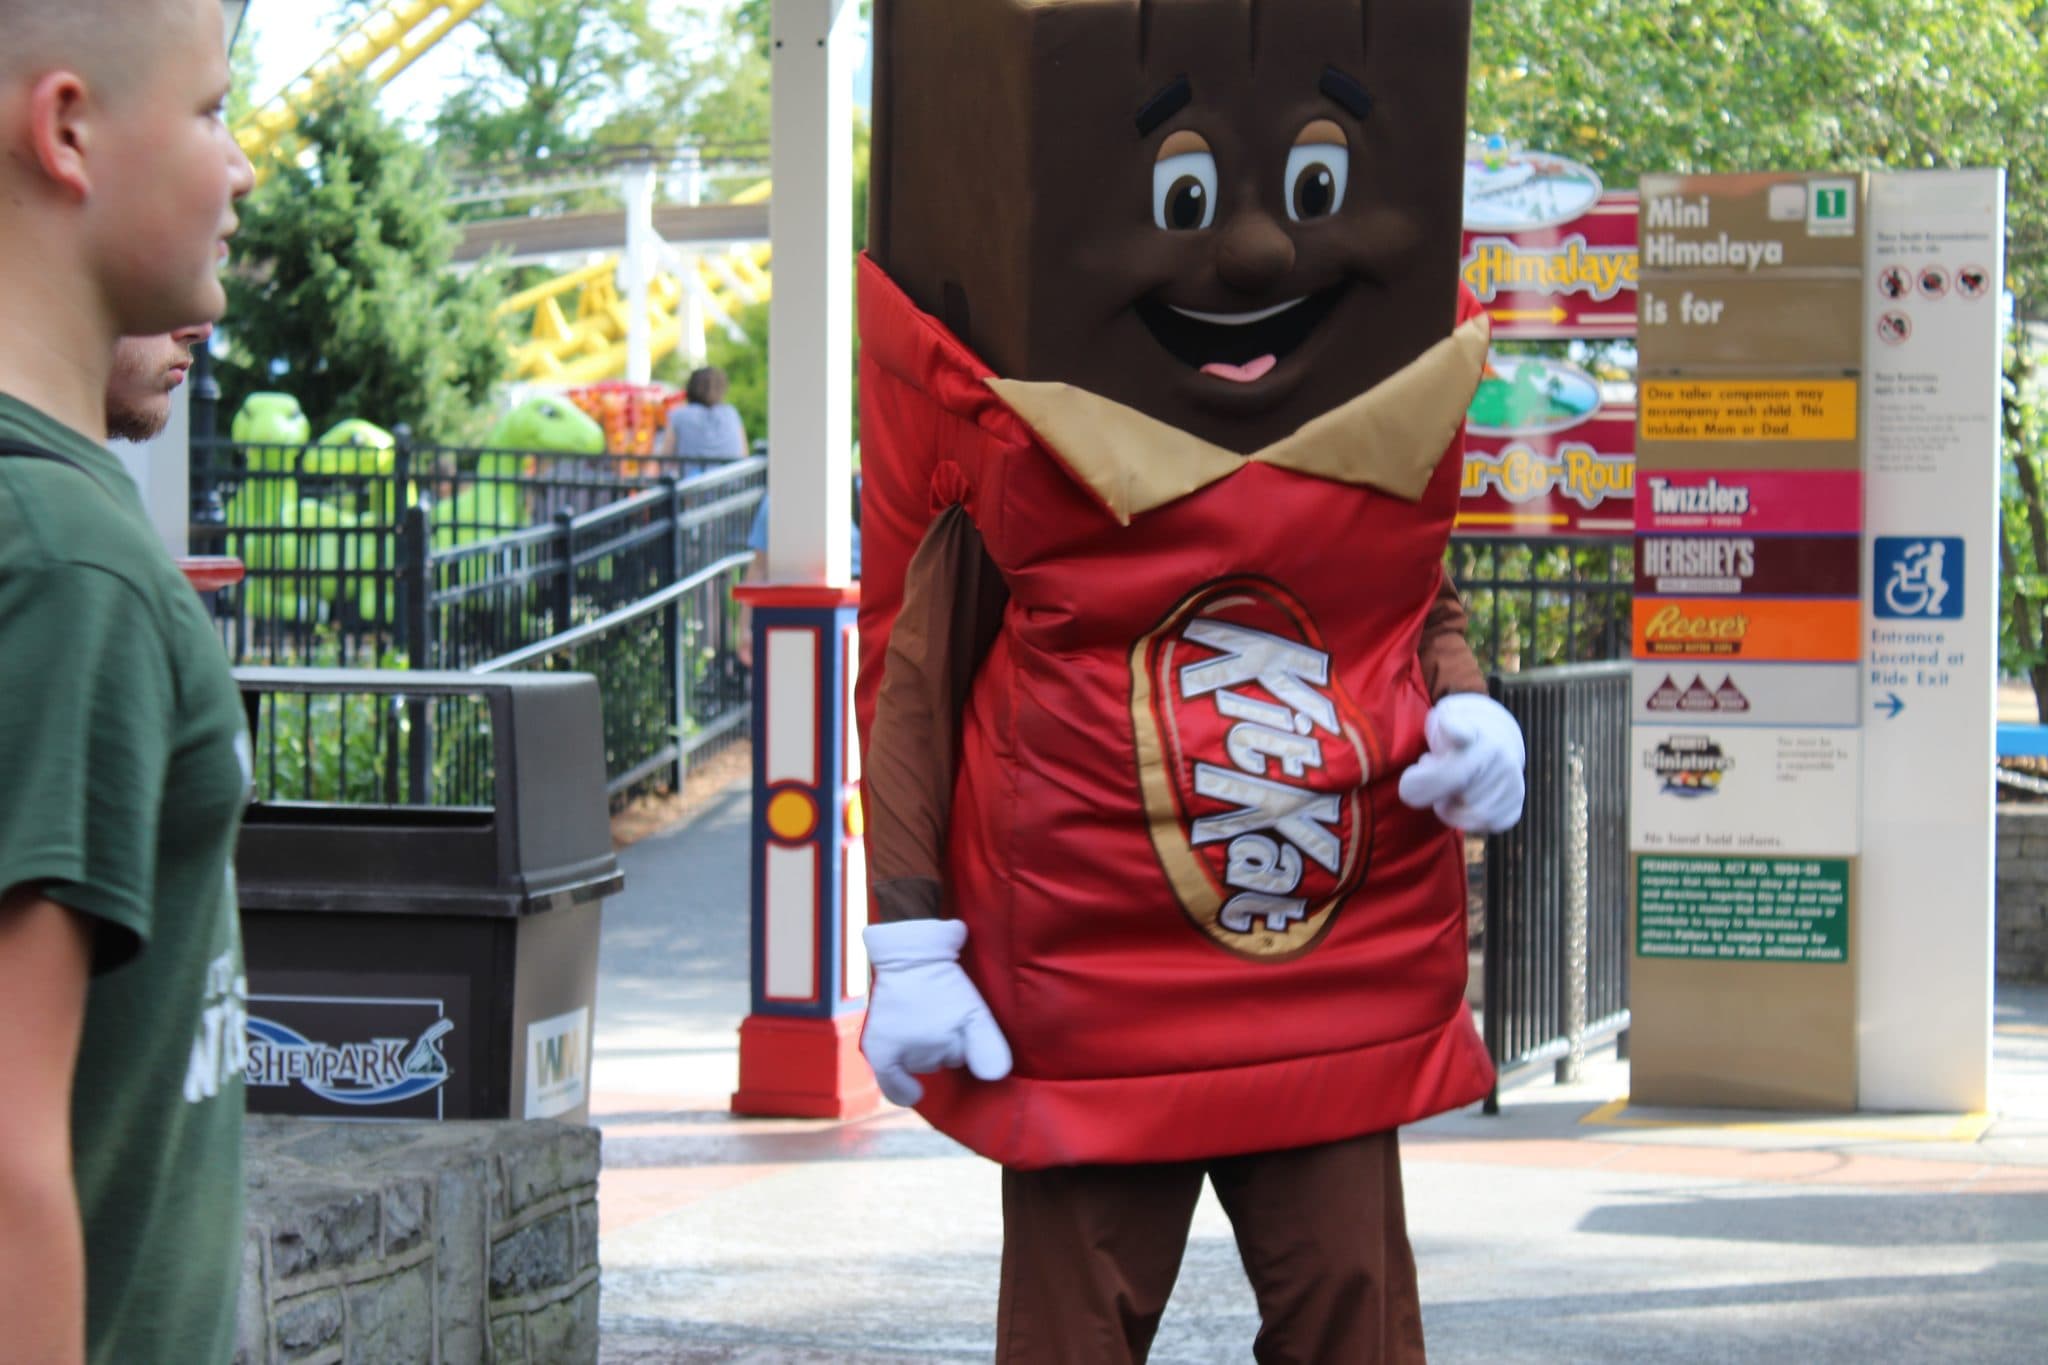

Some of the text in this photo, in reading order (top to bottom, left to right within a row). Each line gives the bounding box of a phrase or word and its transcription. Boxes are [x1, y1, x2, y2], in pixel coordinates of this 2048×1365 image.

[1646, 194, 1709, 227] Mini
[1825, 190, 1836, 217] 1
[1646, 232, 1783, 273] Himalaya
[1644, 291, 1724, 324] is for
[1648, 387, 1824, 403] One taller companion may
[1647, 406, 1719, 419] accompany
[1727, 404, 1757, 417] each
[1800, 404, 1824, 417] This
[1647, 423, 1697, 435] includes
[1704, 424, 1736, 435] Mom
[1741, 426, 1755, 435] or
[1647, 476, 1750, 515] Twizzlers
[1644, 538, 1754, 577] HERSHEY'S
[1645, 604, 1749, 639] Reese's
[1872, 630, 1944, 644] Entrance
[1872, 651, 1964, 665] Located at
[1872, 671, 1949, 686] Ride Exit
[1645, 832, 1663, 844] No
[1669, 832, 1699, 845] hand
[1706, 832, 1733, 845] held
